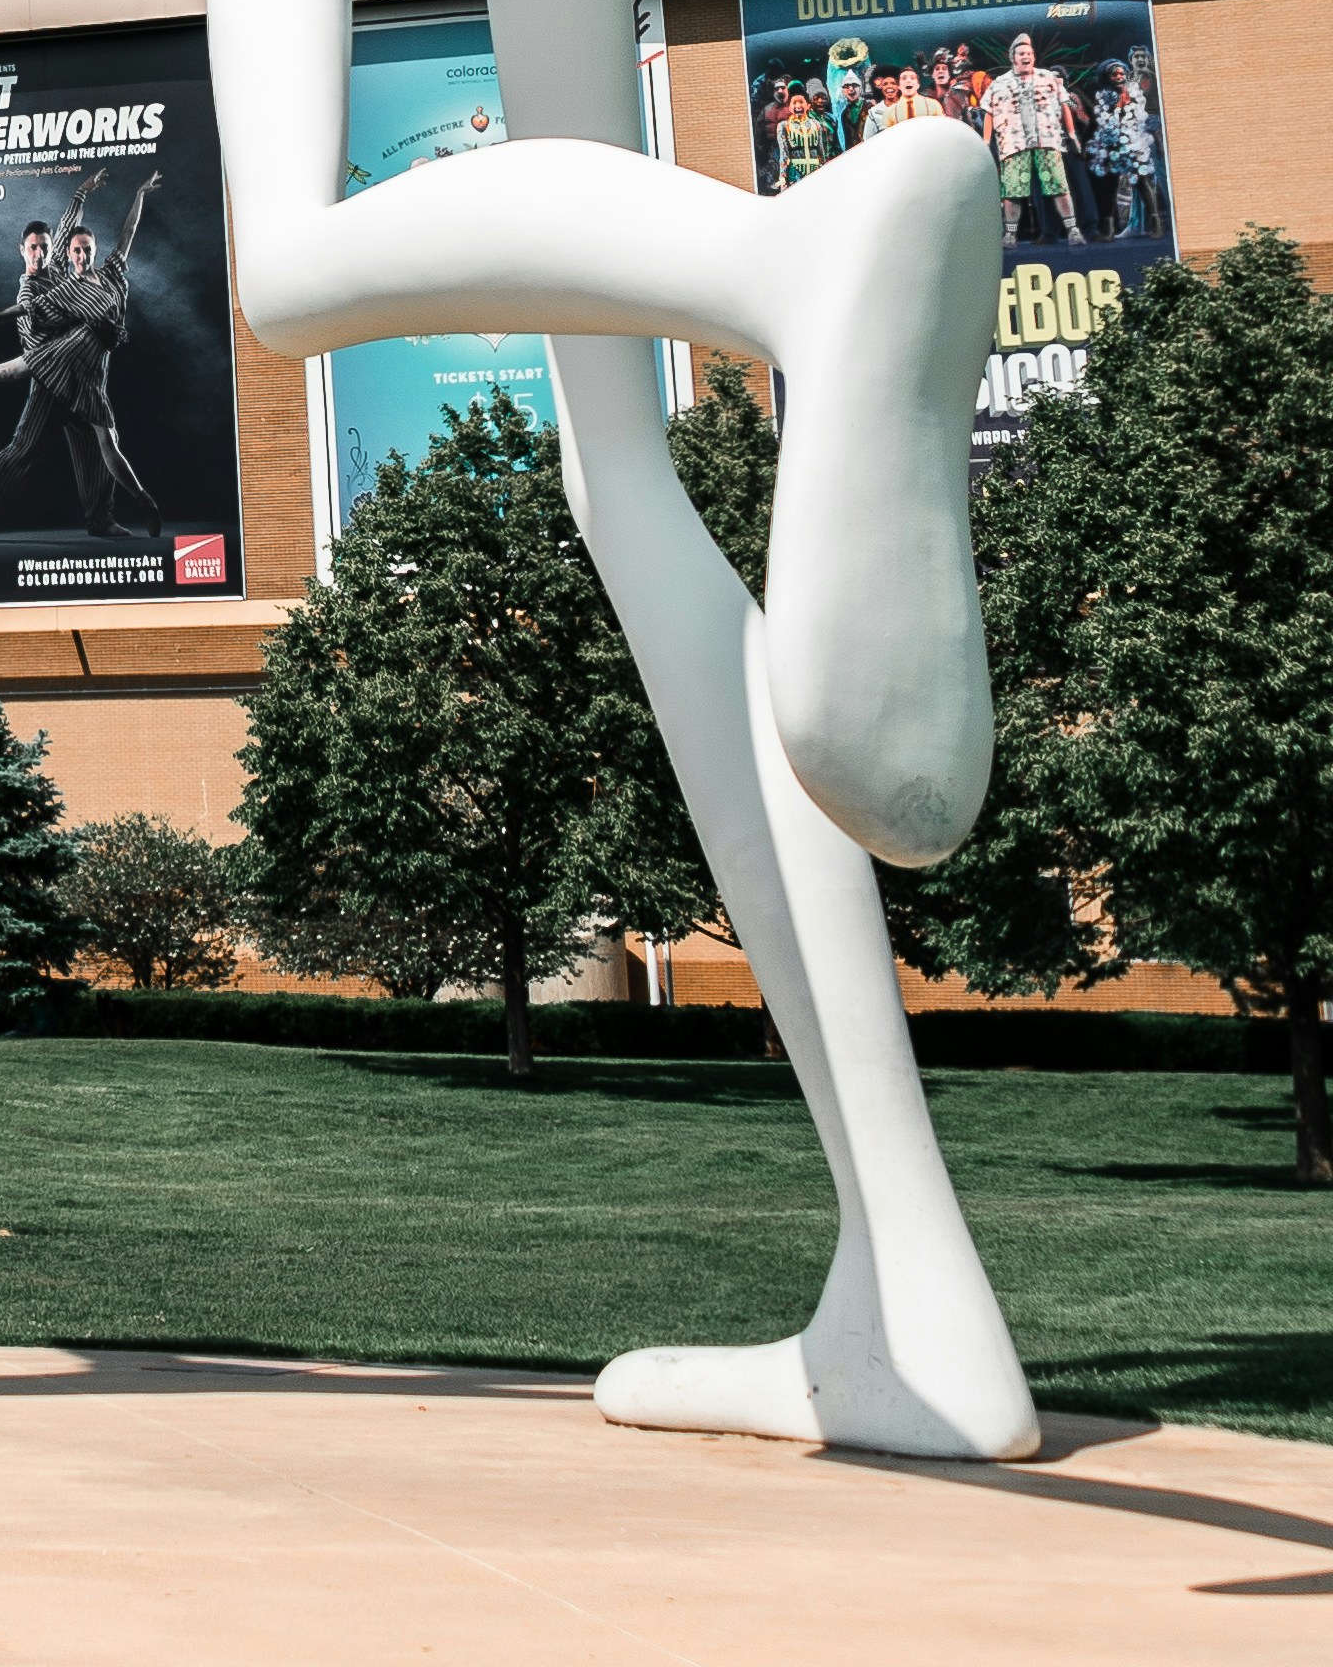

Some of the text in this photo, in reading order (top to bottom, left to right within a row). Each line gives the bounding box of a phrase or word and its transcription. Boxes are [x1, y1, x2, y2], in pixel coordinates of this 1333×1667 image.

[381, 119, 465, 160] ALL PURPOSE CURE
[3, 152, 31, 165] PETITE
[32, 150, 59, 163] MORT
[67, 149, 78, 160] IN
[79, 147, 95, 159] THE
[97, 145, 126, 157] UPPER
[128, 143, 157, 155] ROOM
[434, 370, 495, 385] TICKETS
[499, 368, 544, 381] START
[184, 558, 221, 567] COLORADO
[17, 570, 164, 587] COLORADOBALLET.ORG
[184, 566, 221, 579] BALLET
